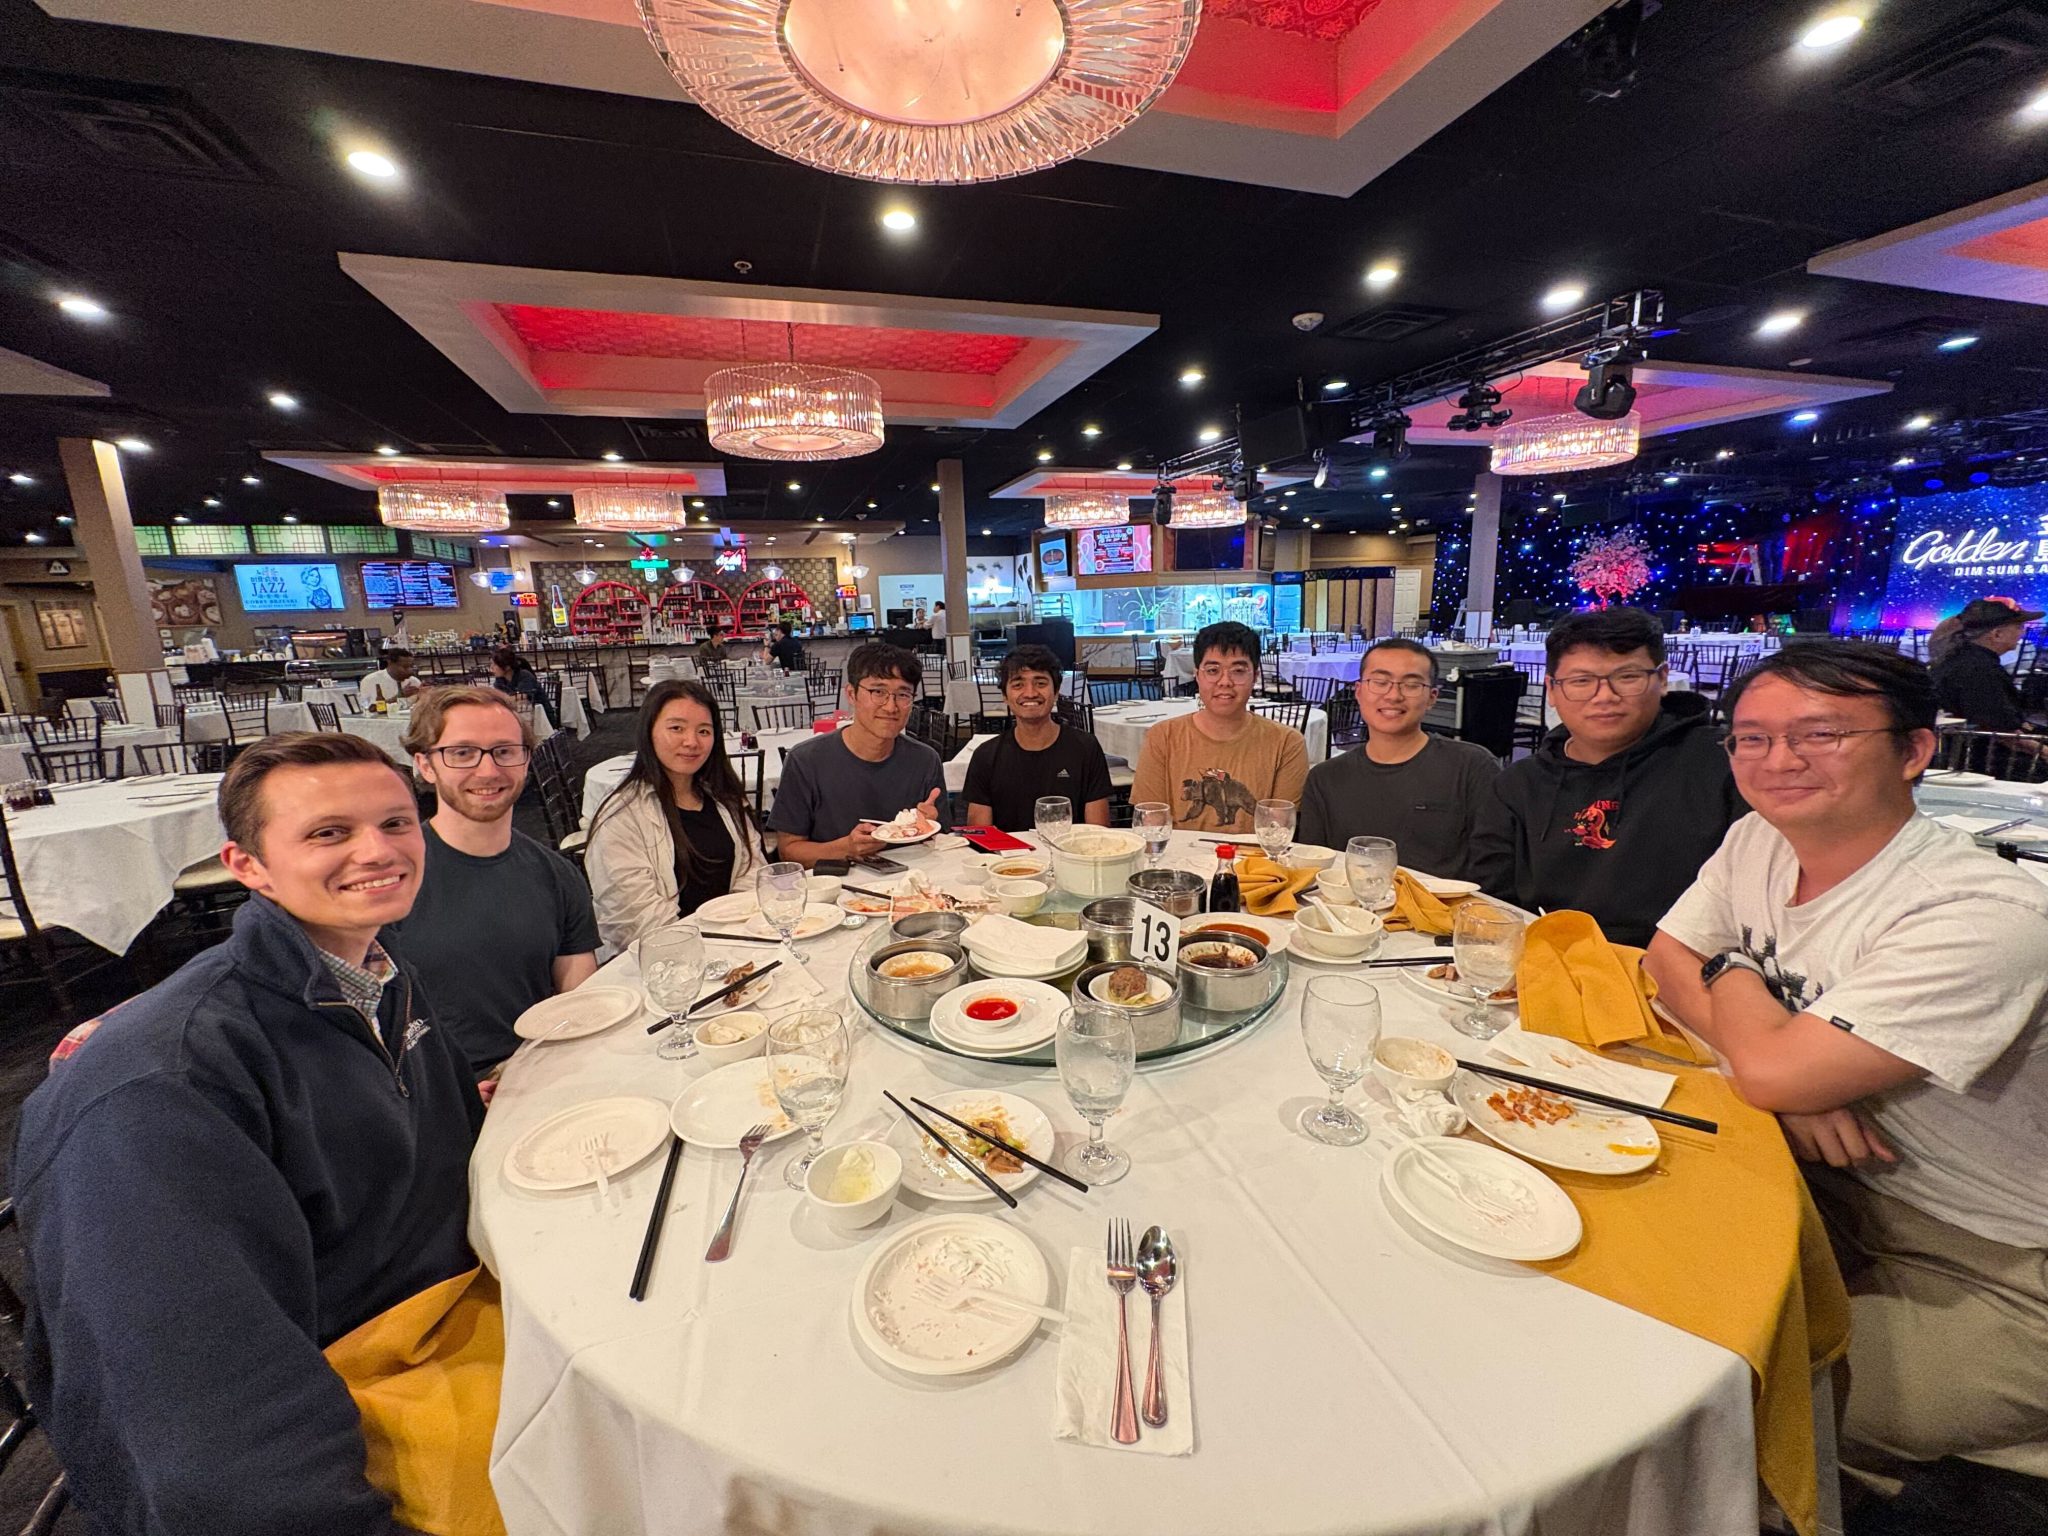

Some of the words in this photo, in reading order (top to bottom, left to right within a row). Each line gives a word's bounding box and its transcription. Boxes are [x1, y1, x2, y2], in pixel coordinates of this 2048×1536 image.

[1902, 526, 2030, 571] Golden
[1954, 566, 1984, 577] DIM
[1986, 565, 2020, 575] SUM
[2023, 564, 2035, 574] &
[251, 582, 287, 597] JAZZ
[1141, 914, 1171, 962] 13
